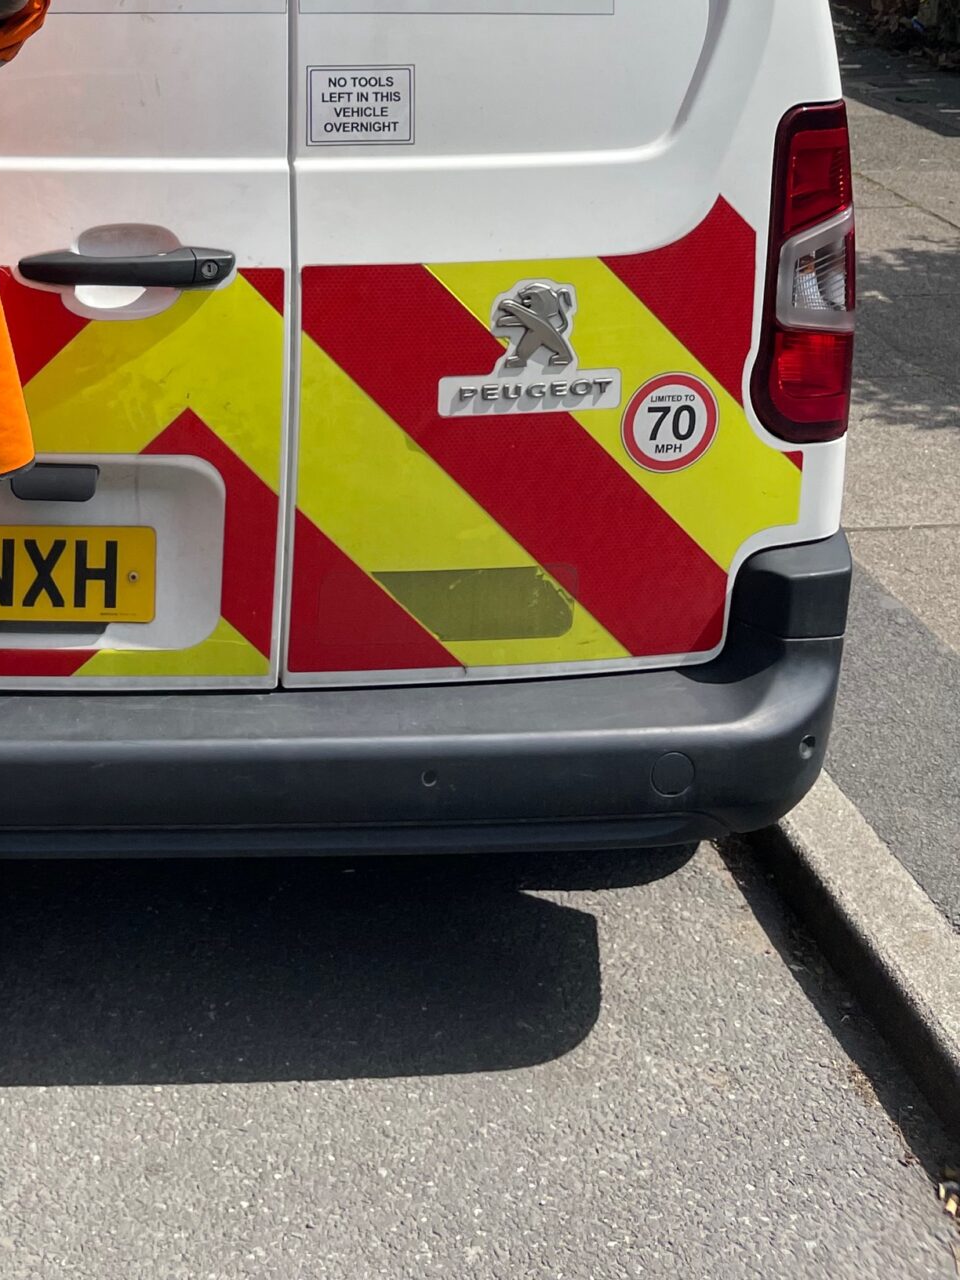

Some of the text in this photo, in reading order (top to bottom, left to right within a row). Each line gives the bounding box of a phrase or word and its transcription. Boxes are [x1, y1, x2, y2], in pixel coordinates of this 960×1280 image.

[328, 76, 394, 88] NO TOOLS
[321, 91, 401, 103] LEFT IN THIS
[333, 106, 389, 117] VEHICLE
[324, 121, 399, 133] OVERNIGHT
[459, 377, 613, 403] PEUGEOT
[650, 394, 696, 403] LIMITED TO
[647, 405, 697, 442] 70
[654, 443, 683, 454] MPH
